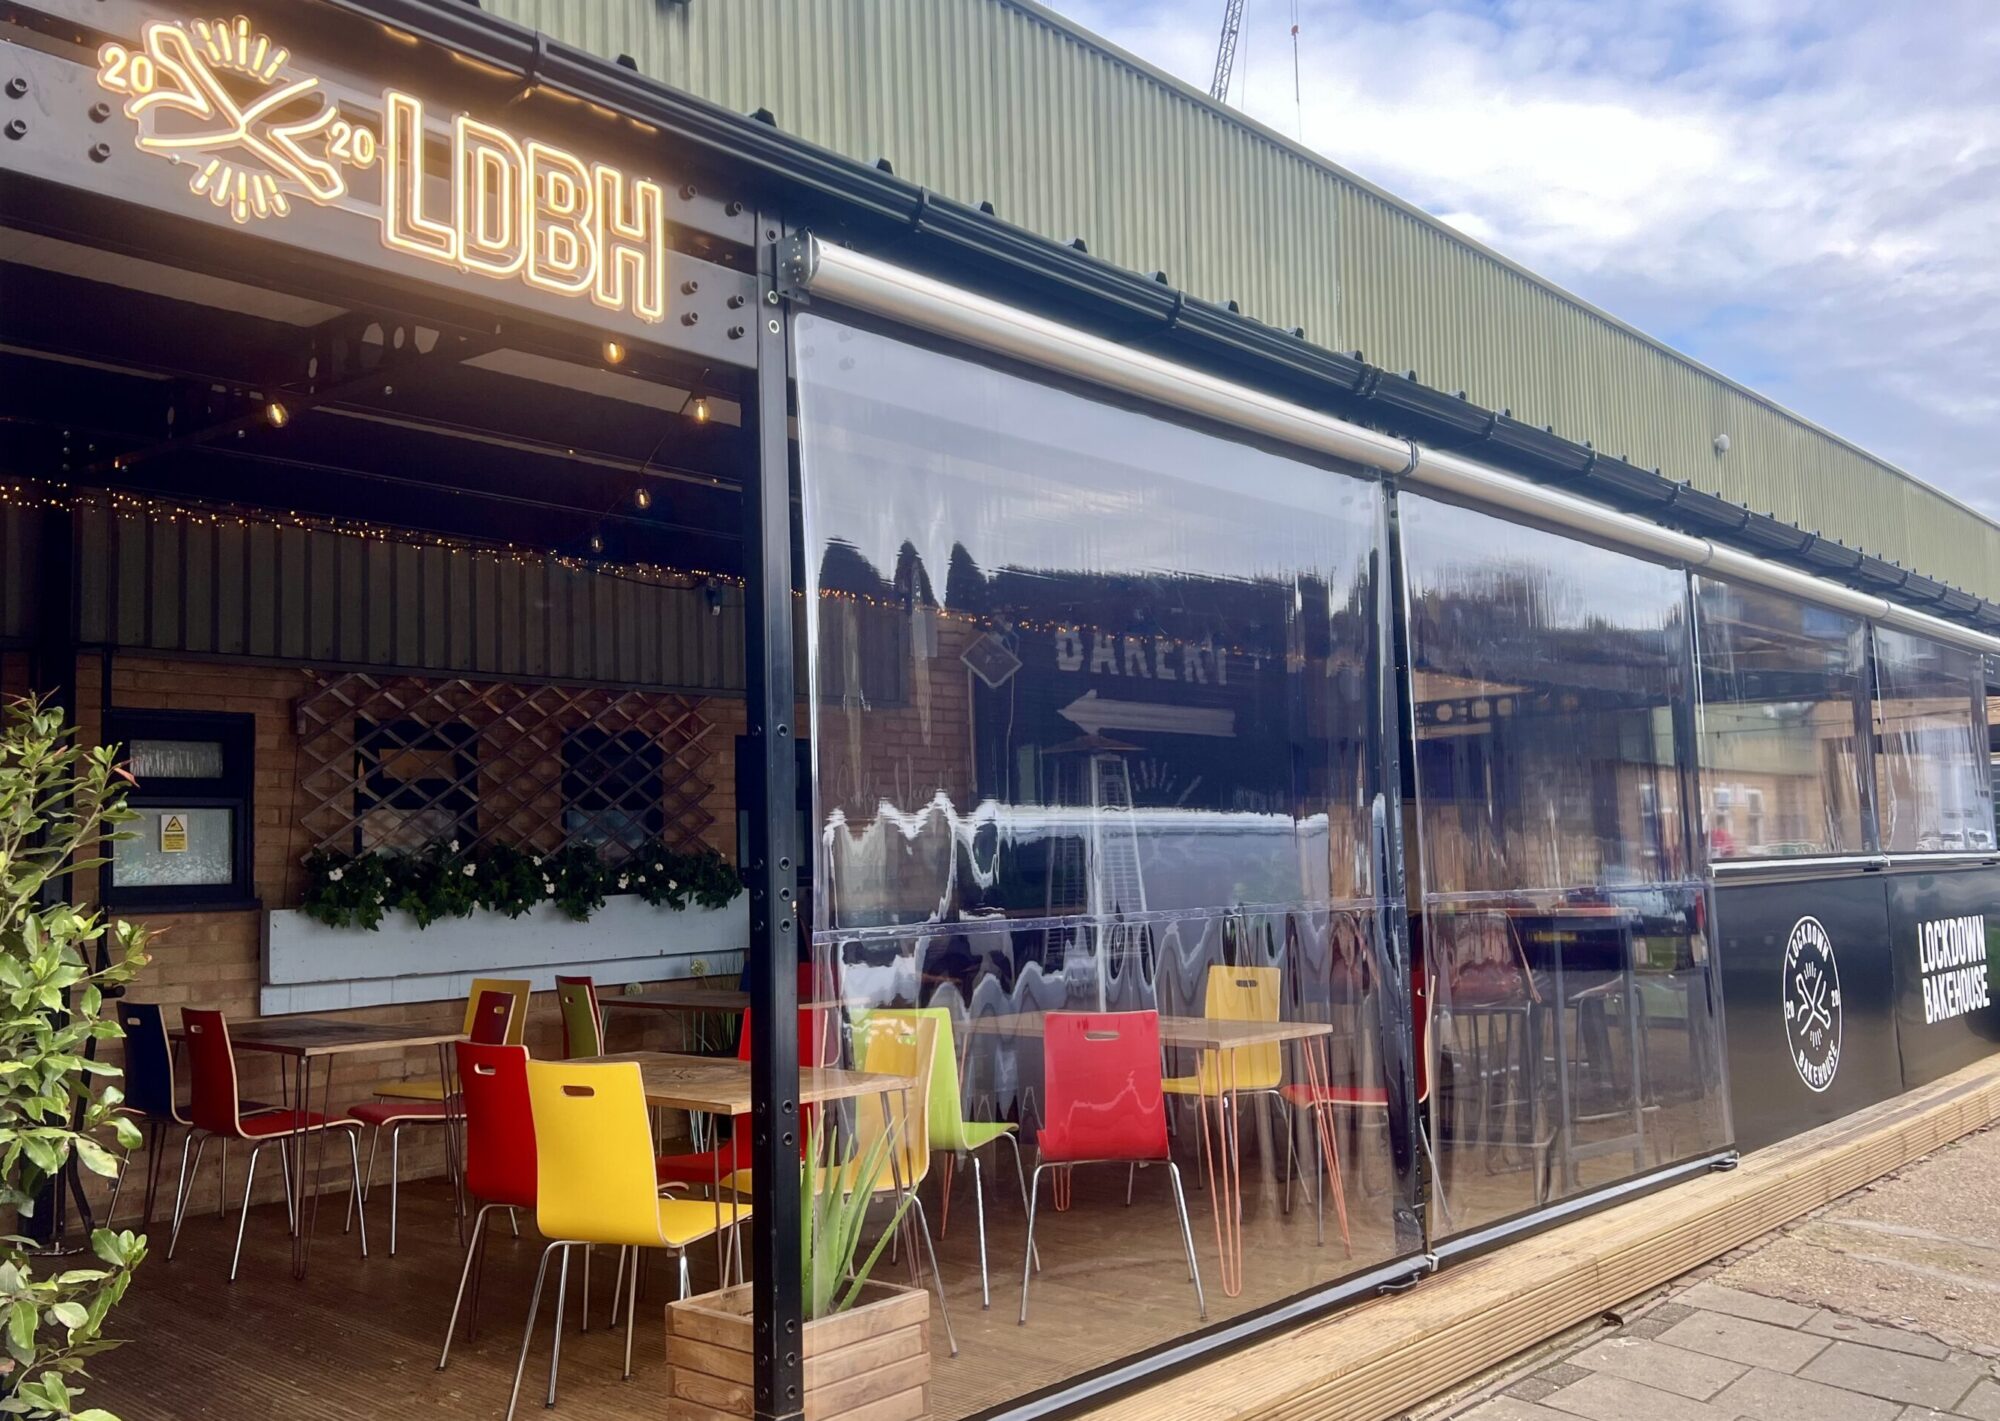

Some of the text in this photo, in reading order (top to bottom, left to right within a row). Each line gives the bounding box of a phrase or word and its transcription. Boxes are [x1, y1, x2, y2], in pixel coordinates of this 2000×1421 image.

[102, 46, 154, 95] 20
[331, 125, 376, 164] 20
[387, 92, 665, 319] LDBH
[1788, 923, 1829, 968] LOCKDOWN
[1918, 915, 1986, 973] LOCKDOWN
[1922, 965, 1990, 1024] BAKEHOUSE
[1798, 1040, 1838, 1086] BAKEHOUSE
